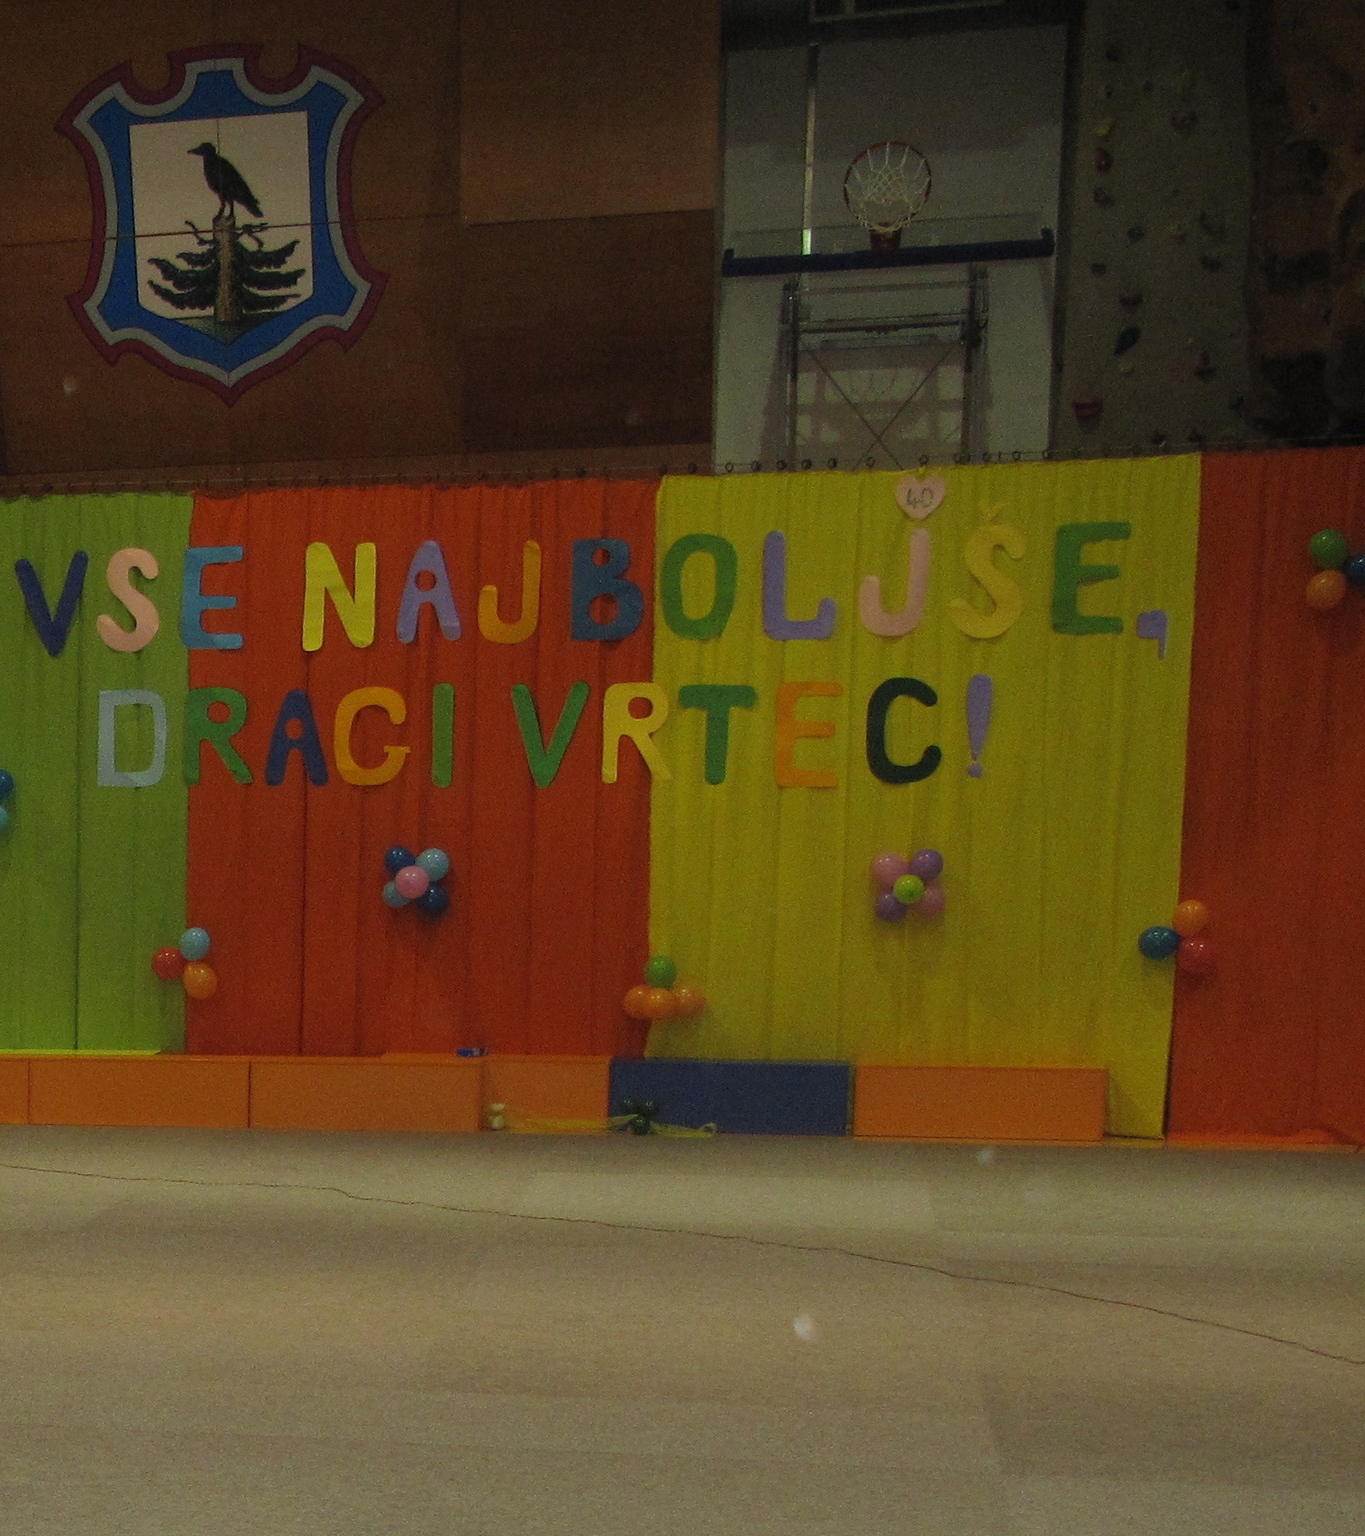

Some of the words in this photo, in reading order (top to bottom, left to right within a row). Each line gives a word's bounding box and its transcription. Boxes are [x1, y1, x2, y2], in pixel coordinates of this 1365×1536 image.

[906, 487, 934, 509] 40
[15, 547, 244, 657] VSE
[97, 683, 455, 788] DRAGI
[511, 673, 994, 788] VRTEC!
